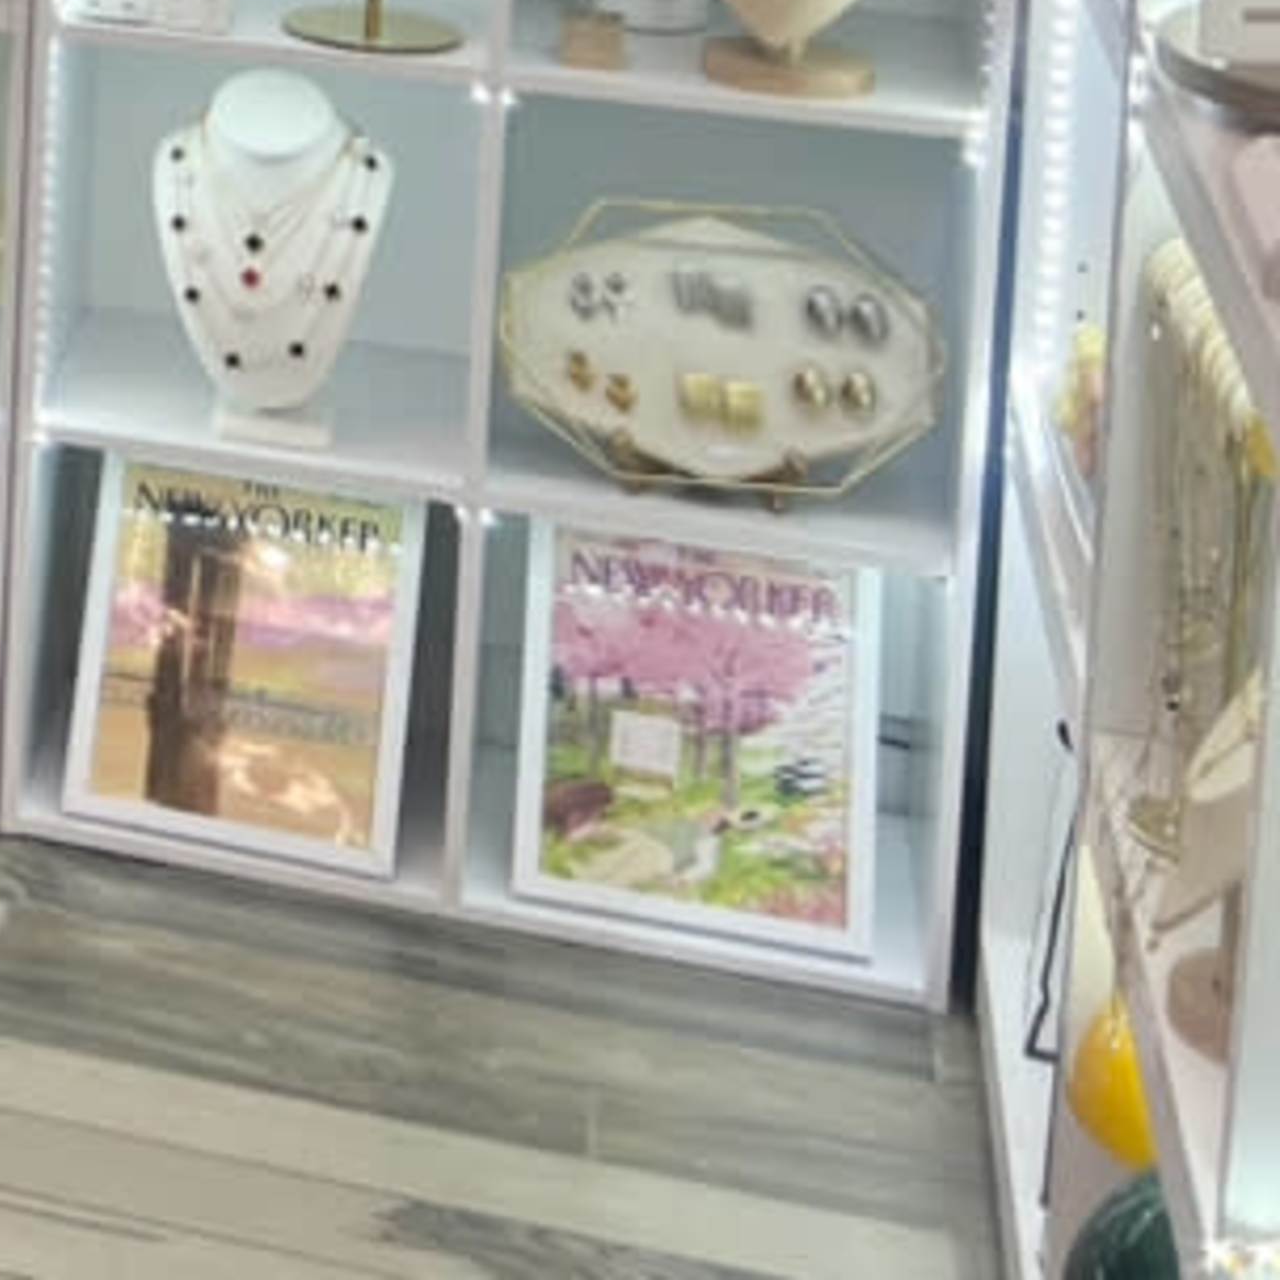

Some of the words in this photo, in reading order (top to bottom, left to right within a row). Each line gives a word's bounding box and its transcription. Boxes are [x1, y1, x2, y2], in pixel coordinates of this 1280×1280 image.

[243, 480, 282, 499] THE
[226, 500, 382, 553] YORKER
[569, 550, 666, 598] NEW
[680, 571, 843, 626] YORKER
